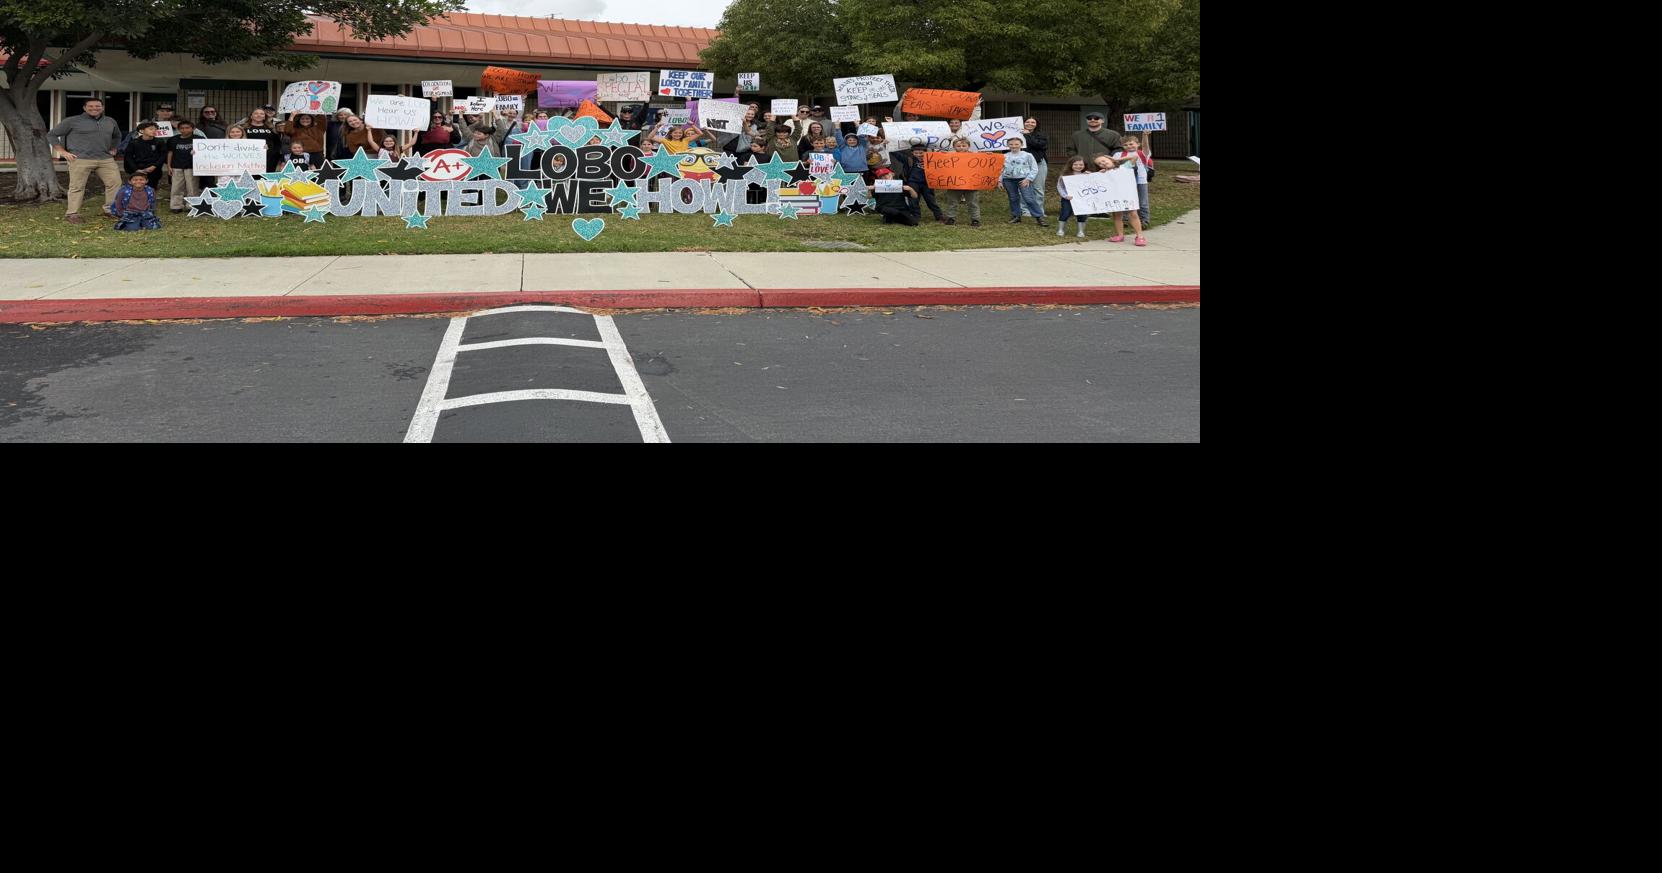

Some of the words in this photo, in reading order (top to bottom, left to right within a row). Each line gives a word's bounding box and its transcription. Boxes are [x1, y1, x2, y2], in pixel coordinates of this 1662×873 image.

[669, 71, 688, 79] KEEP
[661, 79, 681, 87] LOBO
[684, 80, 712, 89] FAMILY
[674, 88, 712, 98] TOGETHER
[378, 106, 398, 114] Hear
[1125, 114, 1141, 122] WE
[1156, 111, 1165, 121] 1
[706, 118, 729, 130] NOT
[1127, 122, 1163, 131] FAMILY
[233, 143, 260, 151] divide
[433, 160, 464, 174] A+
[504, 144, 647, 181] LOBO
[968, 157, 996, 170] OUR
[541, 179, 614, 215] WE
[634, 177, 782, 215] HOWL!
